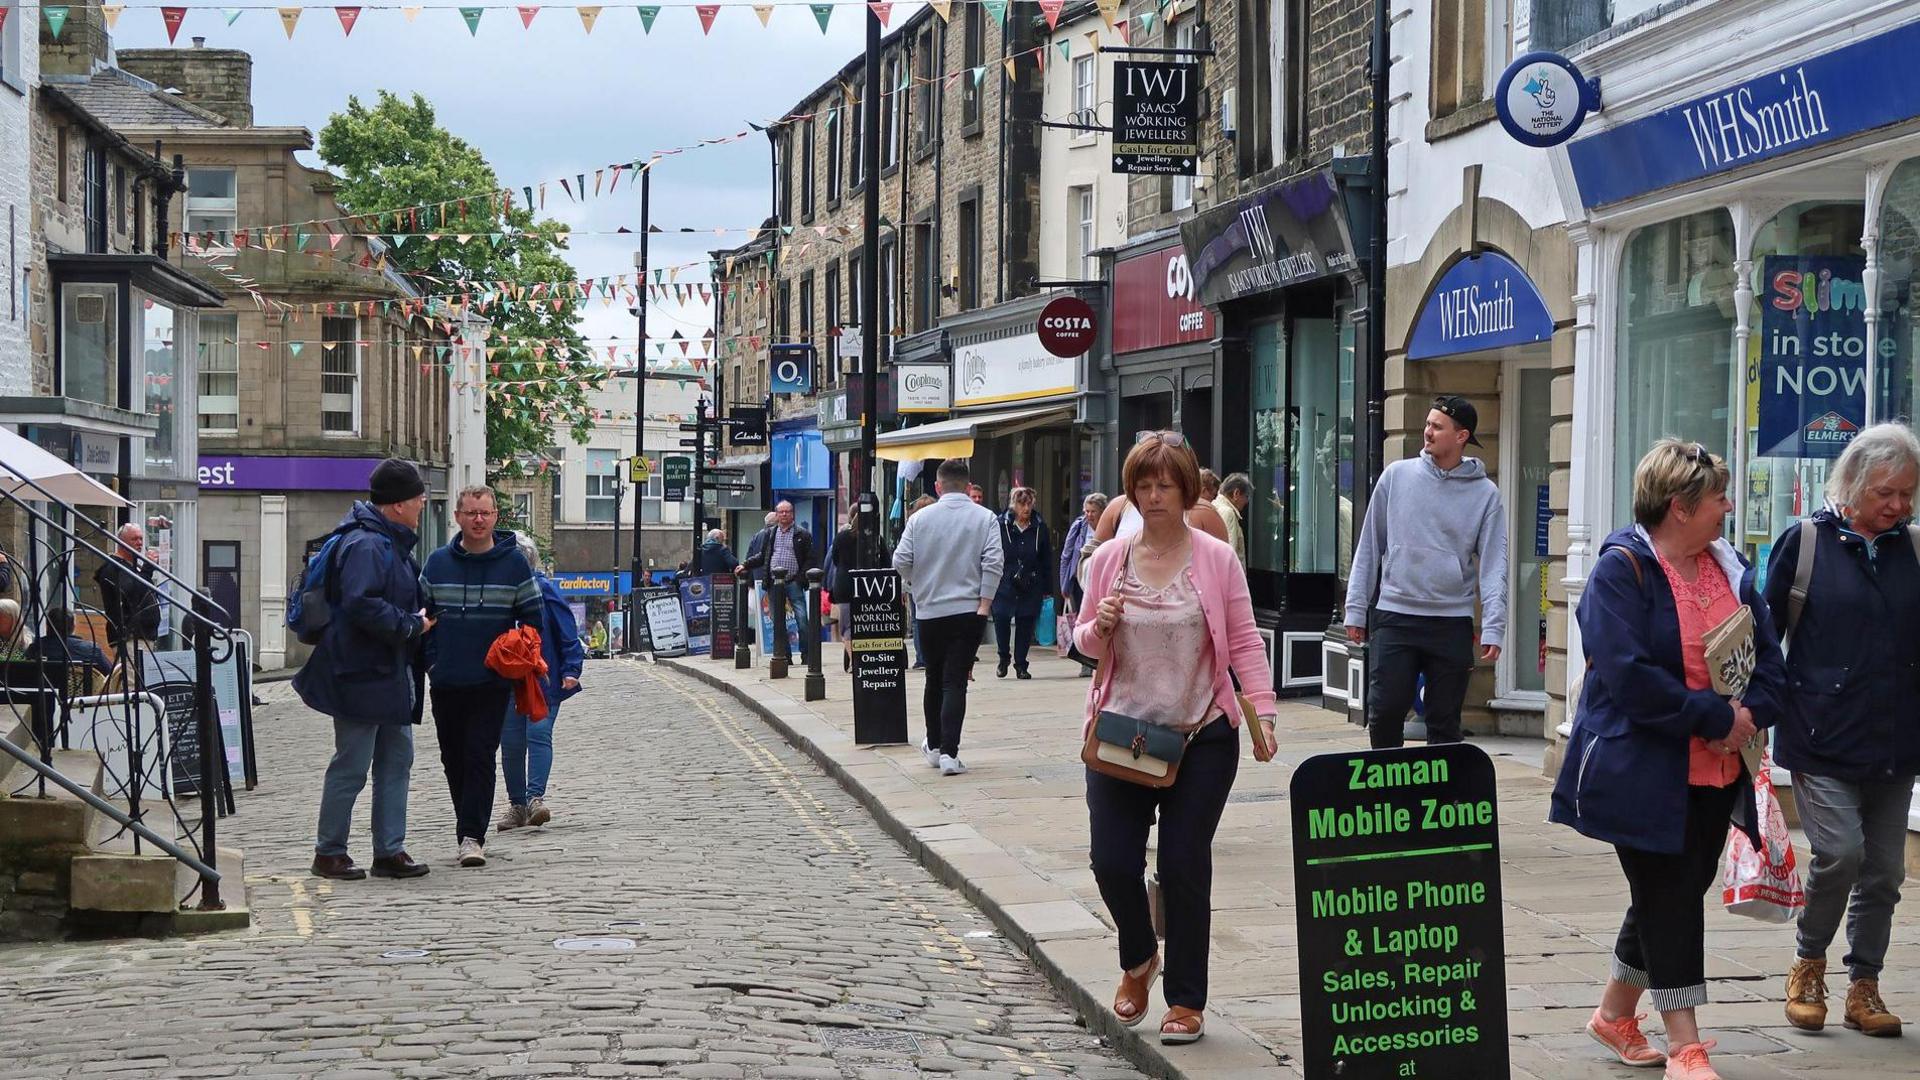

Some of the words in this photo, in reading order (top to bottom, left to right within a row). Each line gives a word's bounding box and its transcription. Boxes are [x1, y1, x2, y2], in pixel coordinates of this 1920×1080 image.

[1126, 67, 1187, 106] IWJ
[1136, 102, 1176, 113] ISAACS
[1125, 115, 1187, 127] WORKING
[1531, 115, 1563, 123] NATIONAL
[1682, 66, 1830, 171] WHSmith
[1125, 129, 1187, 141] JEWELLERS
[1119, 145, 1144, 153] Cash
[1147, 145, 1161, 153] for
[1165, 145, 1190, 154] Gold
[1136, 155, 1172, 164] Jewellery
[1127, 163, 1153, 173] Repair
[1154, 164, 1182, 173] Service
[1239, 205, 1275, 264] IWJ
[1227, 268, 1252, 294] ISAACS
[1248, 263, 1281, 287] WORKING
[1278, 252, 1317, 280] JEWELLERS
[1439, 278, 1515, 342] WHSmith
[1044, 317, 1092, 330] COSTA
[1179, 311, 1204, 332] COFFEE
[1772, 328, 1800, 356] in
[1813, 331, 1898, 358] stoe
[734, 431, 762, 440] Clarks
[1807, 430, 1857, 442] ELMER'S
[559, 575, 610, 592] cardfactory
[852, 575, 897, 602] IWJ
[861, 603, 892, 612] ISAACS
[853, 613, 900, 623] WORKING
[854, 623, 901, 634] JEWELLERS
[884, 640, 902, 648] Gold
[861, 653, 896, 663] On-Site
[857, 667, 900, 678] Jewellery
[862, 680, 897, 690] Repairs
[1348, 758, 1448, 790] Zaman
[1308, 802, 1410, 840] Mobile
[1421, 799, 1493, 830] Zone
[1311, 884, 1398, 919] Mobile
[1407, 880, 1486, 910] Phone
[1344, 928, 1363, 957] &
[1372, 923, 1459, 957] Laptop
[1323, 968, 1396, 993] Sales,
[1404, 958, 1482, 987] Repair
[1331, 995, 1452, 1024] Unlocking
[1460, 990, 1477, 1011] &
[1332, 1023, 1479, 1057] Accessories
[1399, 1059, 1417, 1077] at
